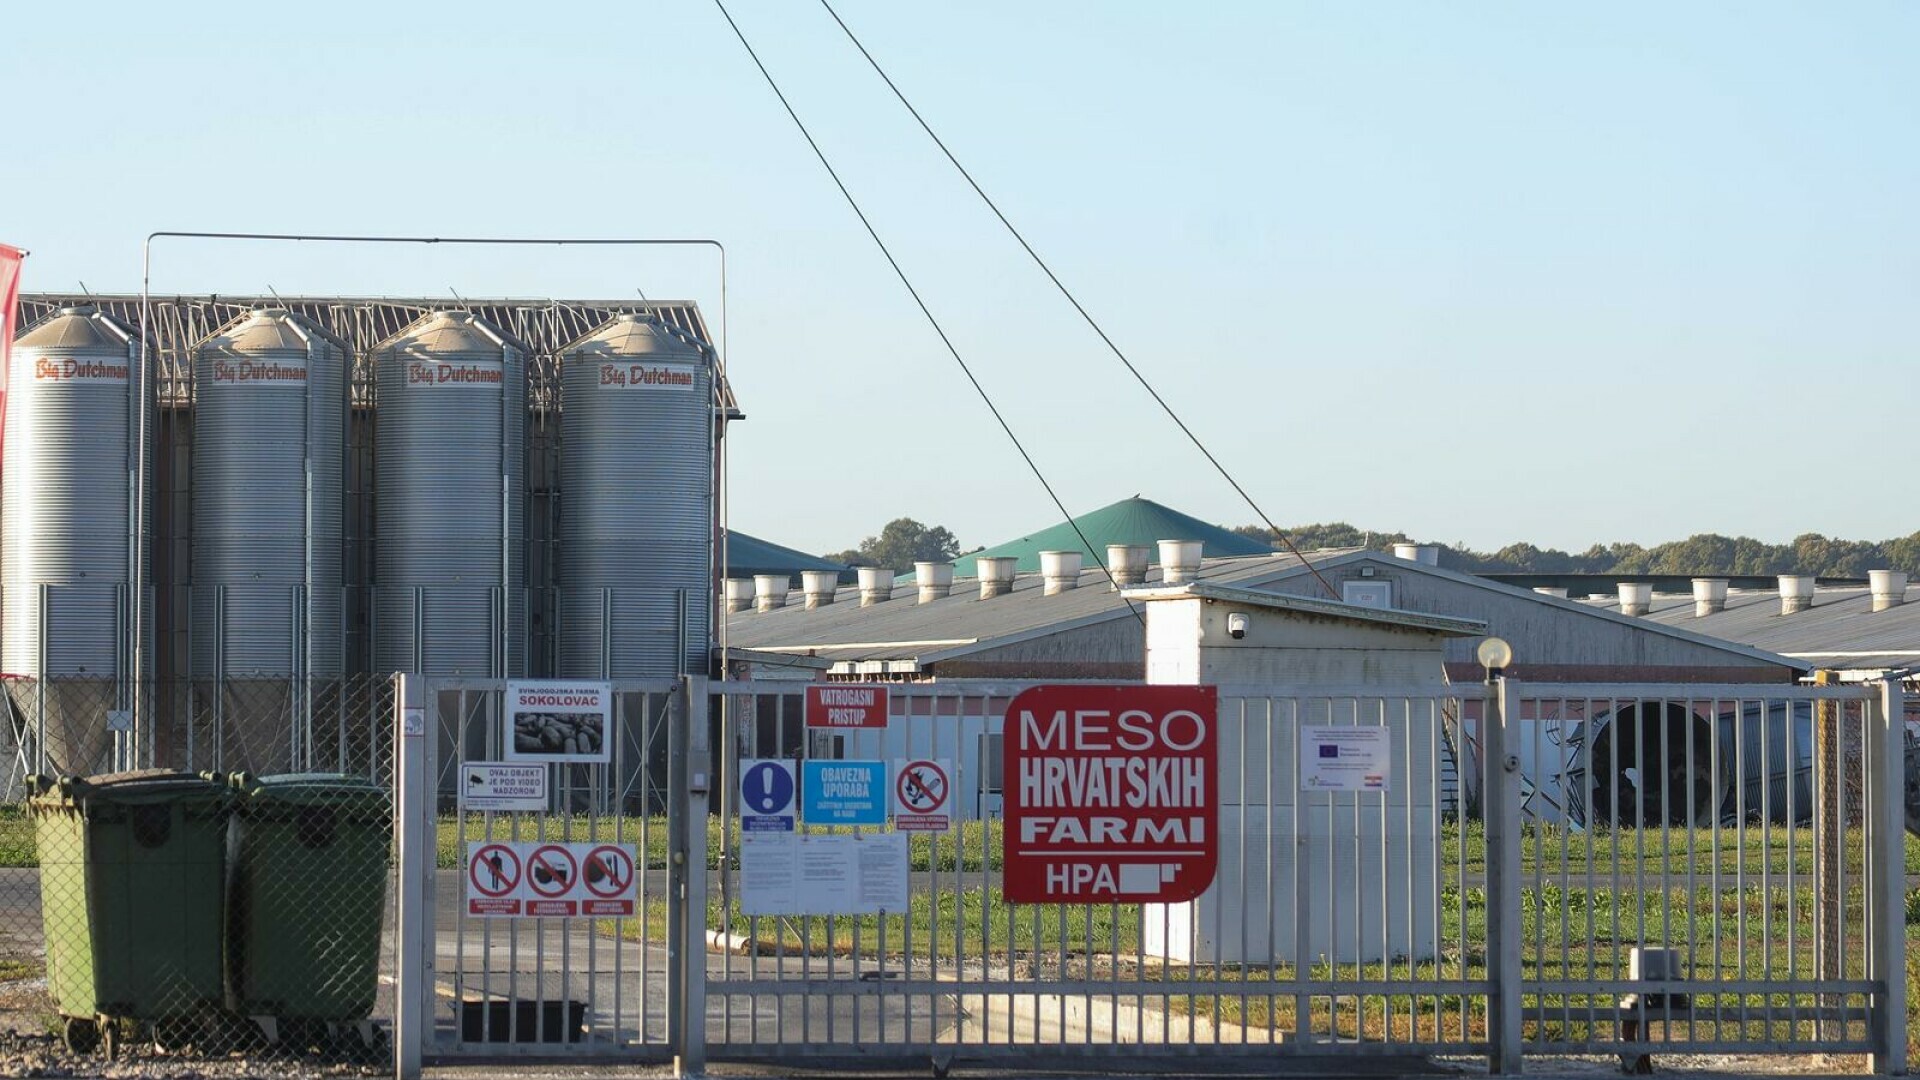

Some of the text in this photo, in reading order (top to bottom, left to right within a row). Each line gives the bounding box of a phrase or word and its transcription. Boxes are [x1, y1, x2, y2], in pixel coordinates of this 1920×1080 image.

[35, 357, 128, 381] Big Dutchman
[214, 360, 307, 384] Big Dutchman
[409, 363, 502, 386] Big Dutchman
[600, 364, 692, 388] Big Dutchman
[519, 695, 599, 706] SOKOLOVAC
[820, 689, 874, 706] VATROGASNI
[828, 708, 866, 725] PRISTUP
[1020, 710, 1206, 751] MESO
[489, 769, 540, 777] OVAJ OBJEKT
[500, 778, 516, 786] POD
[518, 778, 541, 786] VIDEO
[821, 767, 872, 783] OBAVEZNA
[1019, 756, 1205, 809] HRVATSKIH
[493, 787, 536, 795] NADZOROM
[822, 782, 870, 798] UPORABA
[1020, 816, 1205, 844] FARMI
[1046, 863, 1118, 895] HPA
